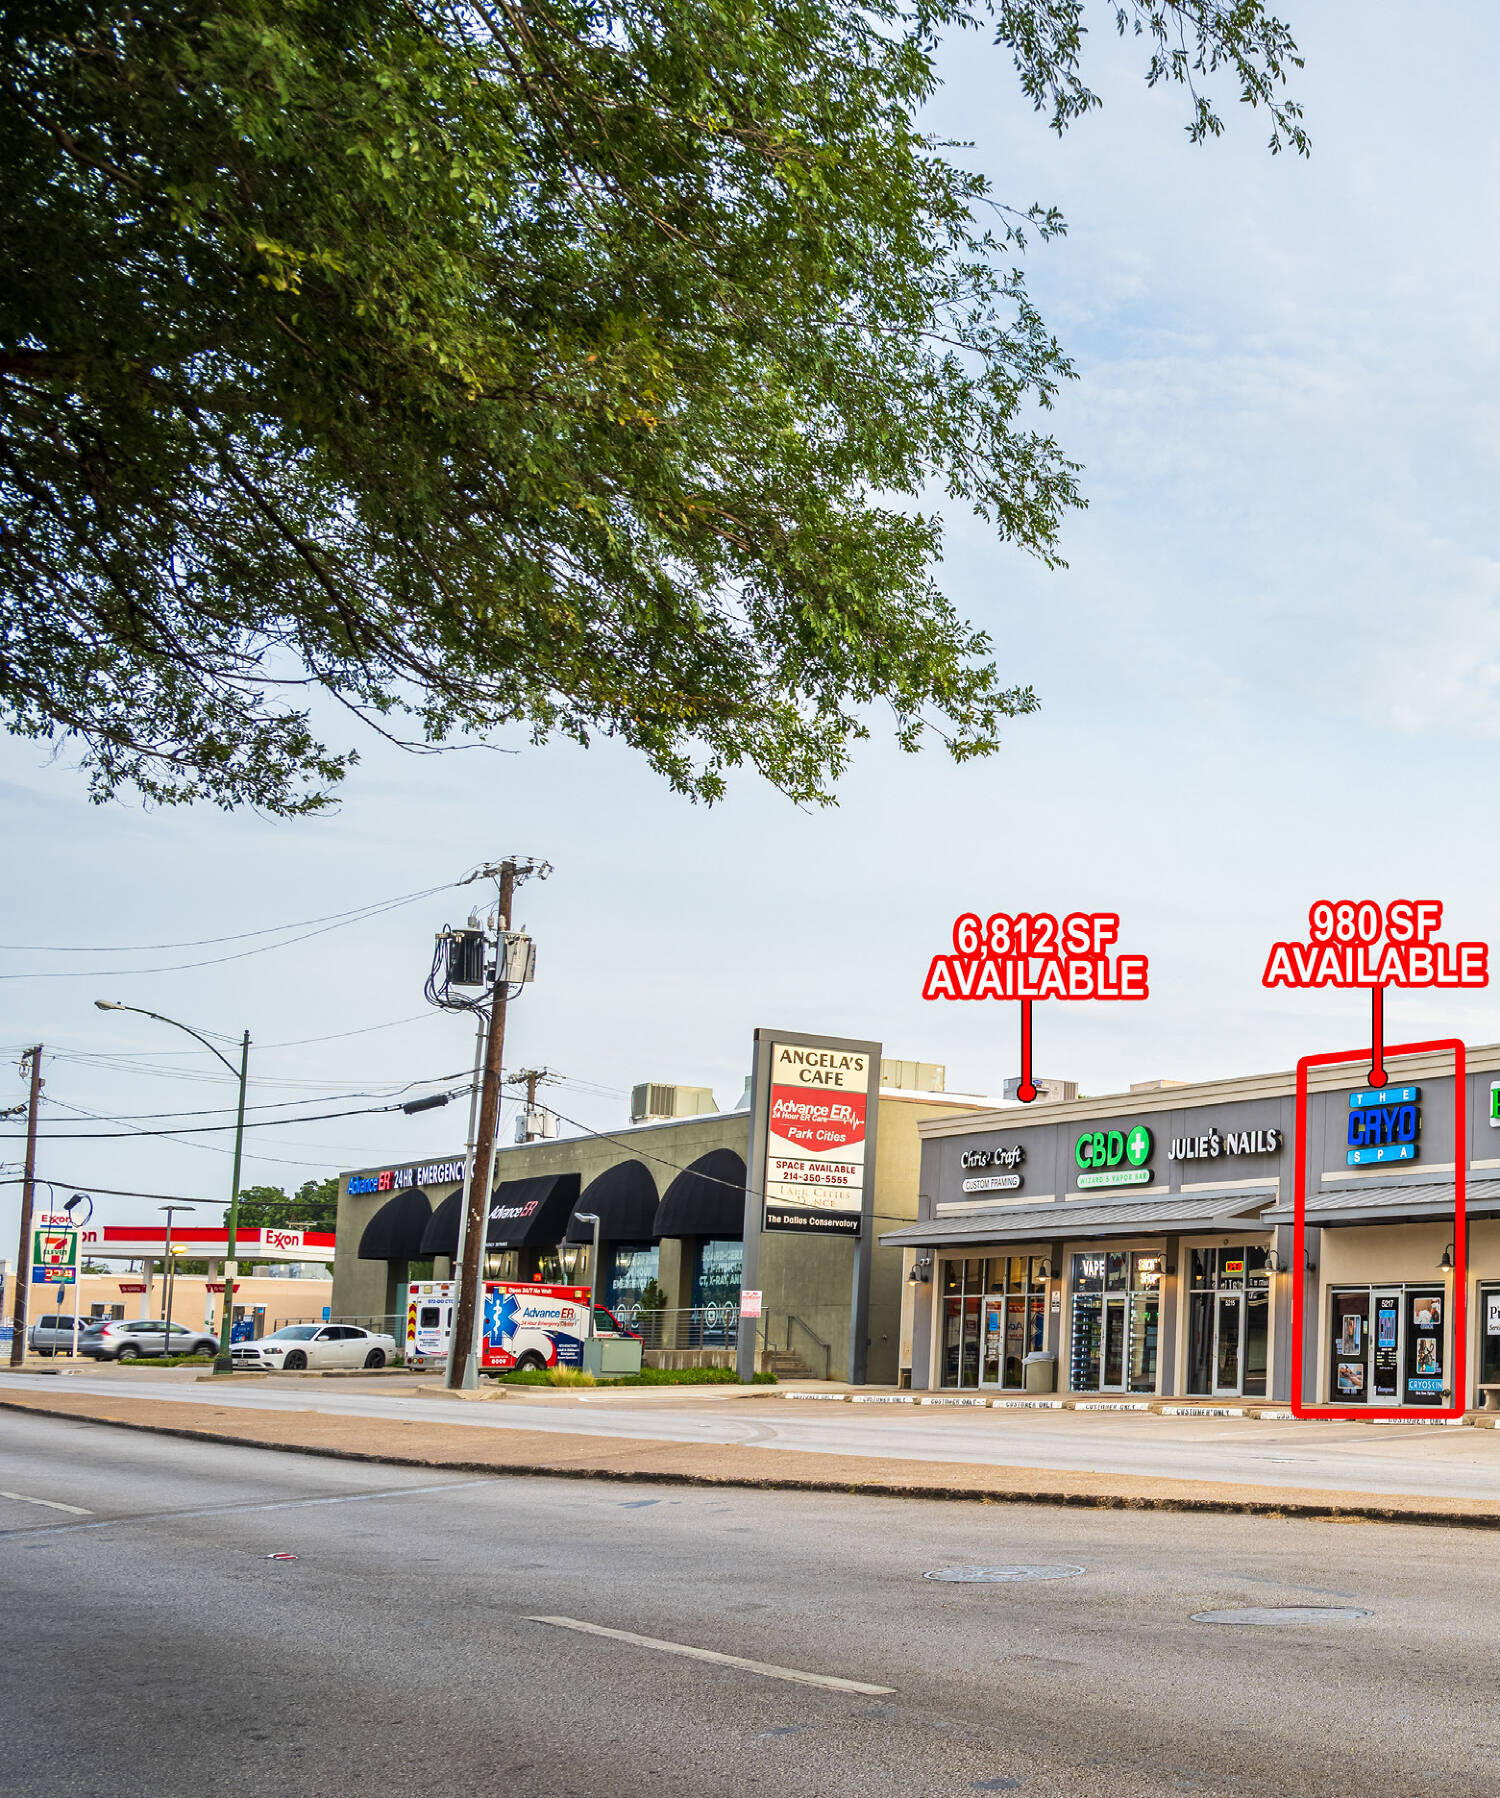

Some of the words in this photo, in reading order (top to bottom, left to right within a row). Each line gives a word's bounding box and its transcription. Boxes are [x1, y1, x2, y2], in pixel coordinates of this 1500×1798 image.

[779, 1049, 864, 1072] ANGELA'S
[799, 1068, 844, 1087] CAFE
[1356, 1089, 1410, 1105] THE
[773, 1099, 829, 1116] Advance
[830, 1104, 852, 1120] ER
[782, 1112, 799, 1121] Hour
[1348, 1105, 1418, 1146] CRYO
[788, 1127, 813, 1139] Park
[816, 1130, 847, 1143] Cities
[1075, 1130, 1124, 1169] CBD
[1168, 1132, 1221, 1161] JULIE'S
[1226, 1128, 1279, 1155] NAILS
[961, 1150, 992, 1169] Chris'
[994, 1146, 1023, 1169] Craft
[1353, 1146, 1408, 1163] SPA
[776, 1160, 804, 1171] SPACE
[809, 1164, 856, 1175] AVAILABLE
[783, 1171, 849, 1185] 214-350-5555
[965, 1178, 990, 1191] CUSTOM
[990, 1175, 1019, 1188] FRAMING
[767, 1214, 782, 1223] The
[783, 1215, 807, 1225] Dallas
[809, 1217, 858, 1230] Conservatory
[266, 1230, 299, 1249] Exxon
[1082, 1260, 1105, 1277] VAPE
[1176, 1408, 1211, 1416] CUSTOMER
